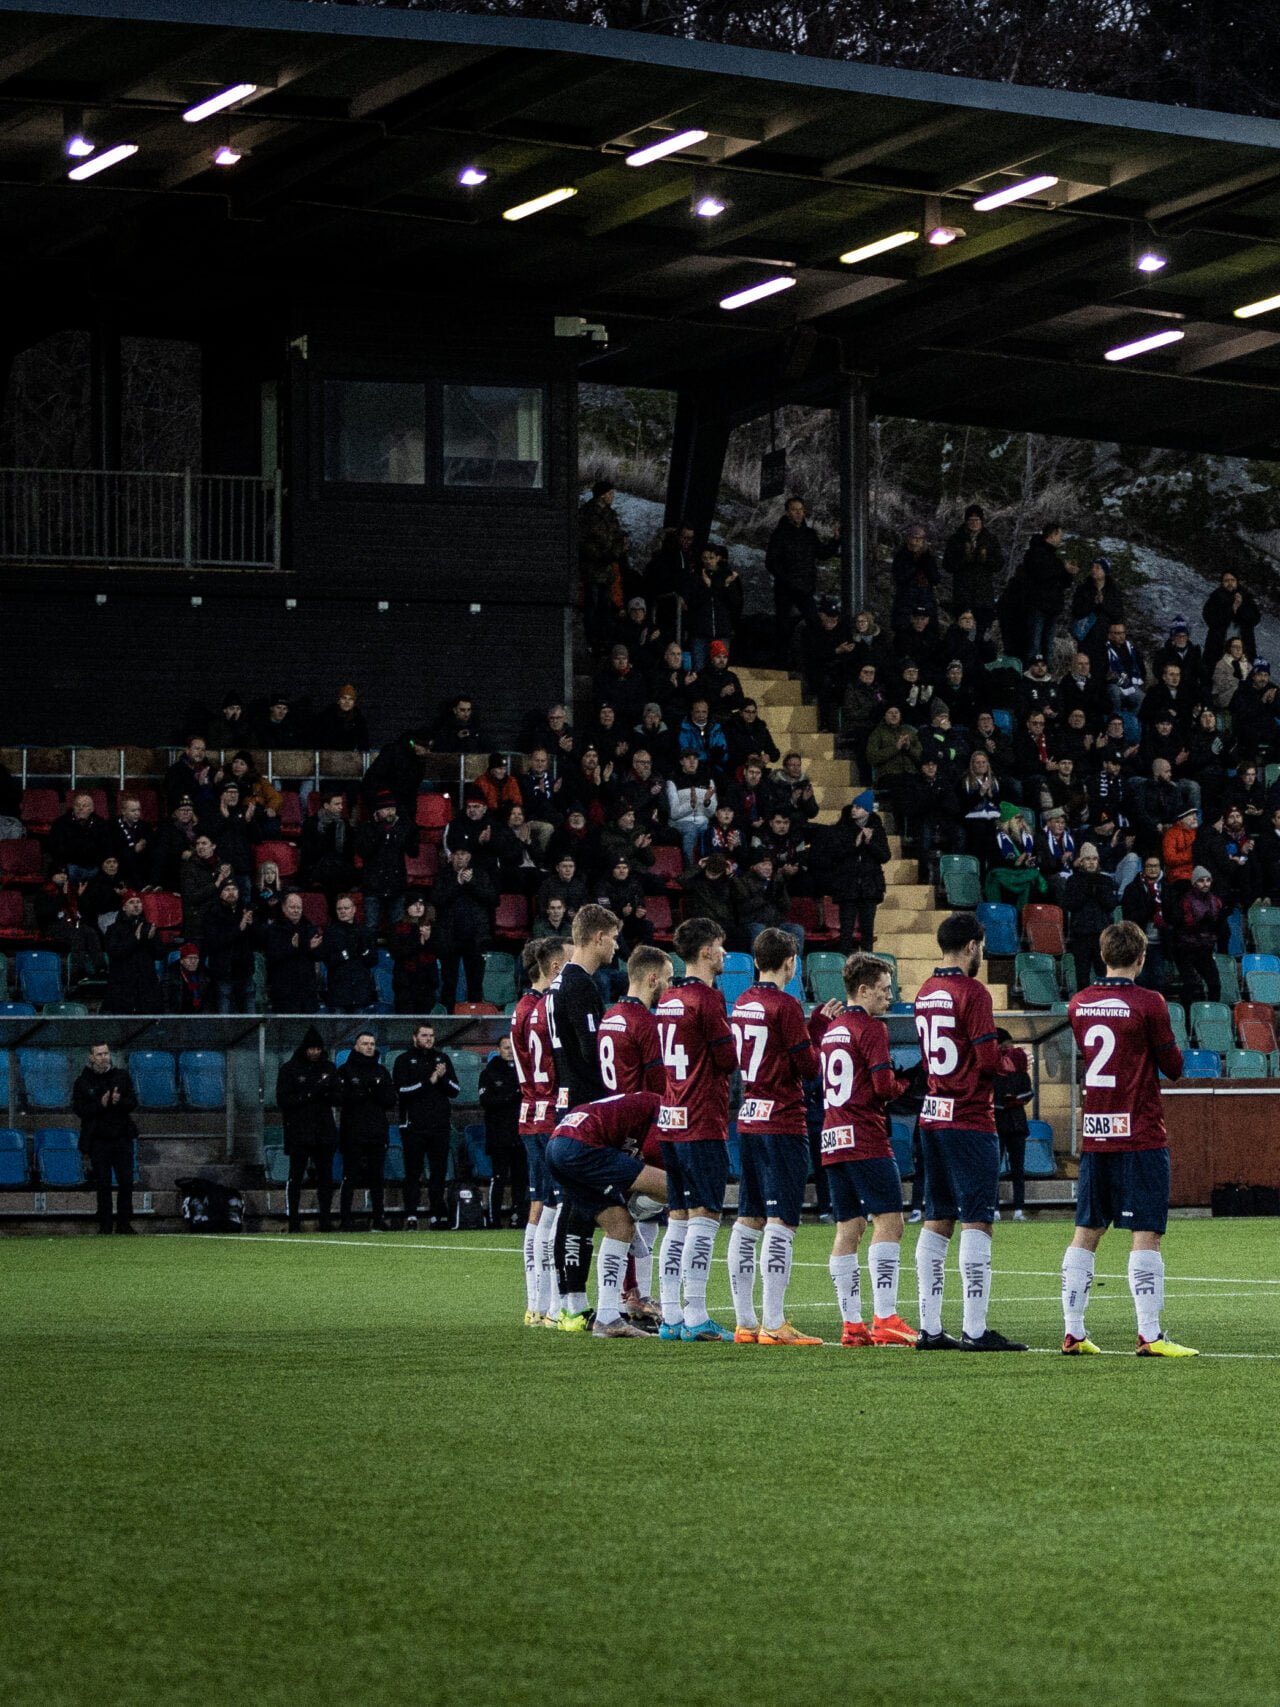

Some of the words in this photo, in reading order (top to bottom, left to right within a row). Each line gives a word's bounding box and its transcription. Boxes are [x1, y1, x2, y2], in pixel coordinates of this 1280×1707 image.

[1075, 1008, 1131, 1018] HAMMARVIKEN
[599, 1035, 618, 1091] 8
[1084, 1024, 1117, 1088] 2
[564, 1234, 581, 1267] MIKE
[664, 1240, 684, 1277] MIKE
[691, 1235, 711, 1271] MIKE
[740, 1236, 756, 1274] MIKE
[768, 1236, 787, 1274] MIKE
[603, 1254, 621, 1288] MIKE
[876, 1259, 897, 1289] MIKE
[931, 1259, 945, 1297] MIKE
[963, 1262, 984, 1299] MIKE
